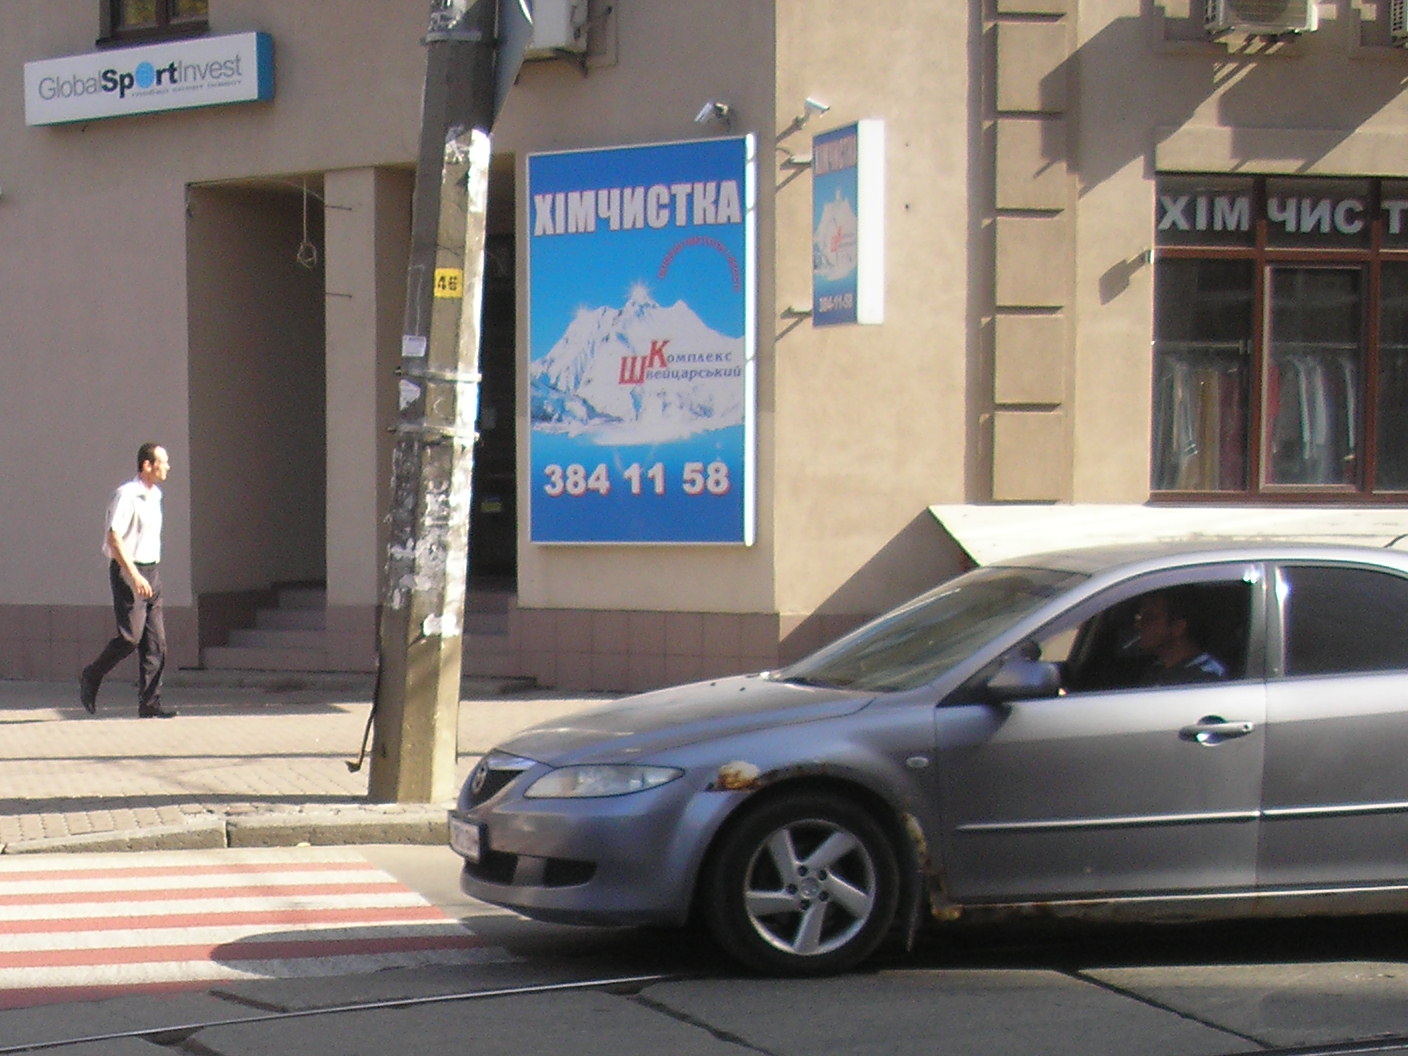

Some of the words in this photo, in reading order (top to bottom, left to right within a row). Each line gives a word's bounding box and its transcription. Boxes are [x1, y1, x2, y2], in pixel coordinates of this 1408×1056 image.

[533, 180, 742, 237] ХІМЧИСТКА
[647, 340, 733, 368] Комплекс
[618, 356, 742, 385] Швейцарський
[544, 463, 611, 497] 384
[623, 462, 665, 496] 11
[682, 462, 732, 496] 58
